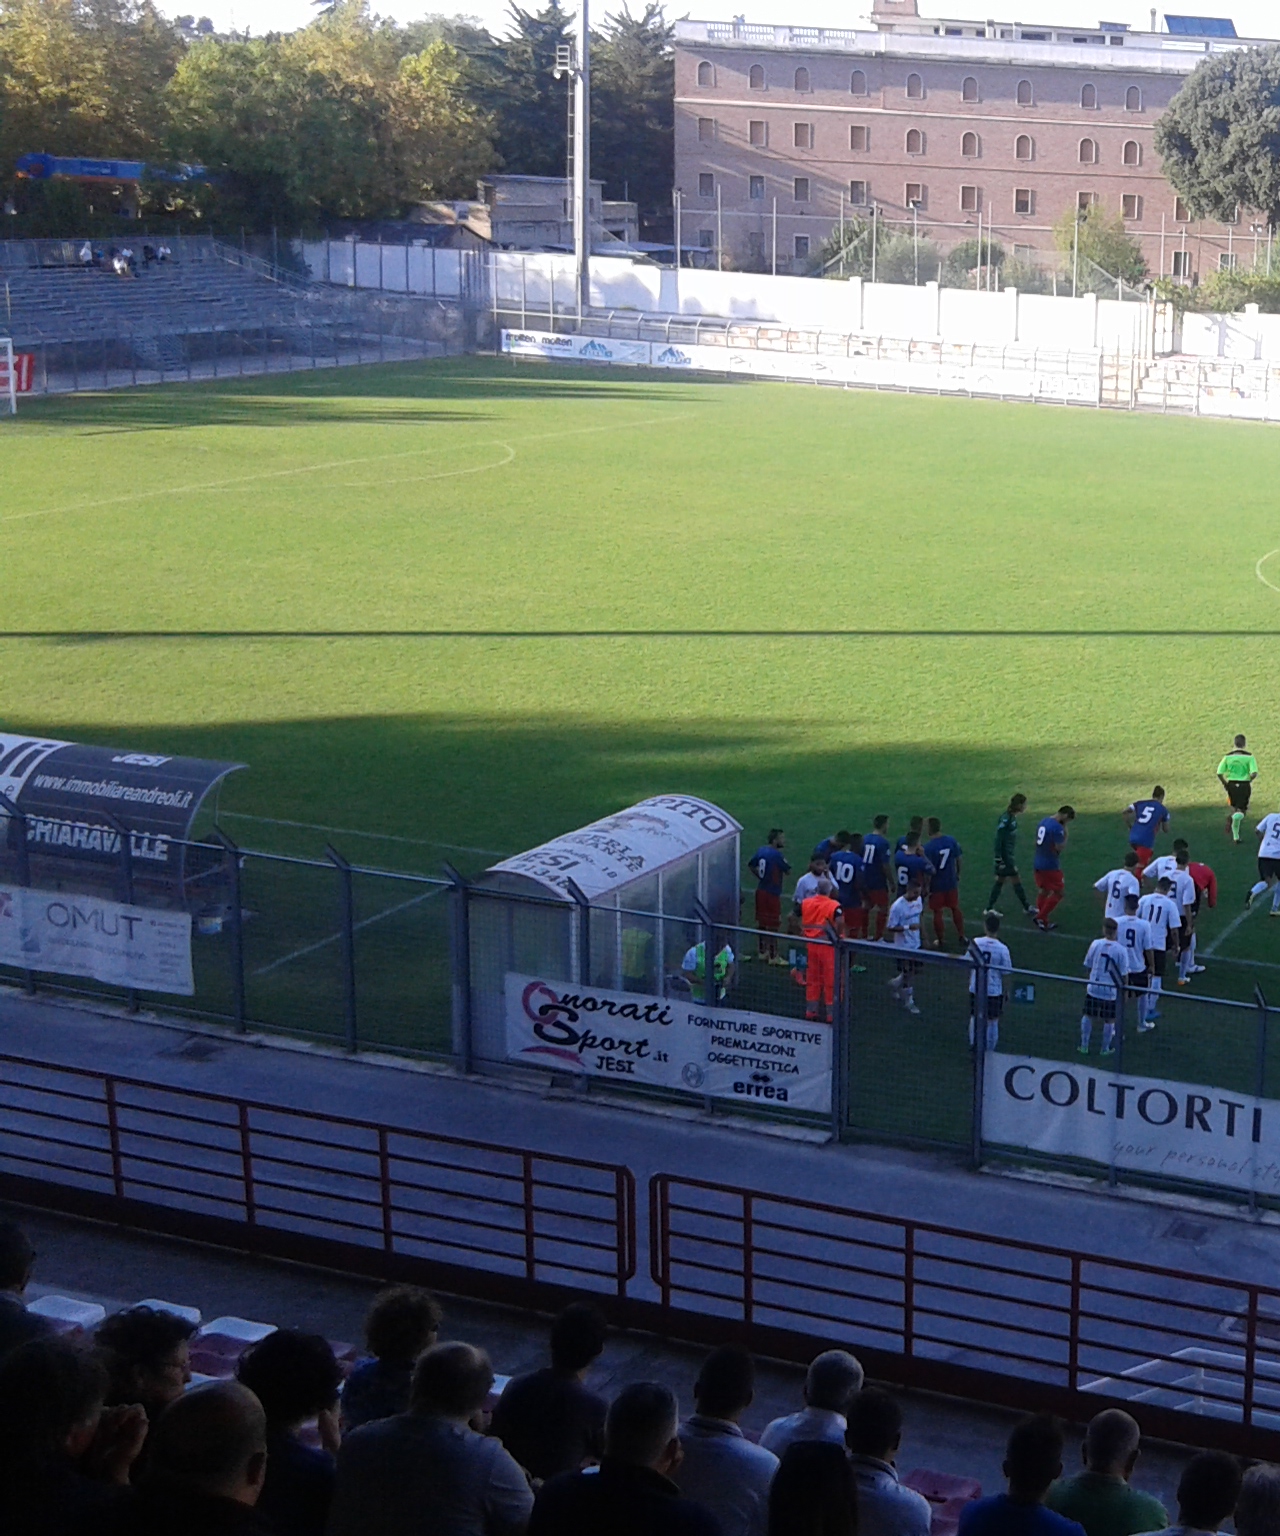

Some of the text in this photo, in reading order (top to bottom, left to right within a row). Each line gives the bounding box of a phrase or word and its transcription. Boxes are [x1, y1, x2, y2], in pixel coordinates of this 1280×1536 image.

[541, 336, 573, 346] molten
[0, 740, 58, 779] li
[112, 753, 173, 767] JESI
[33, 774, 194, 808] www.immobiliareandreoli.it
[1138, 806, 1155, 824] 5
[1036, 826, 1046, 846] 9
[863, 844, 876, 864] 11
[939, 848, 950, 870] 7
[758, 858, 767, 879] 8
[836, 861, 854, 883] 10
[897, 866, 909, 885] 6
[1111, 880, 1121, 899] 6
[46, 902, 143, 940] OMUT
[1148, 904, 1163, 924] 11
[1125, 928, 1136, 949] 9
[1100, 952, 1112, 973] 7
[521, 980, 674, 1027] Onorati
[687, 1014, 822, 1045] FORNITURE SPORTIVE
[711, 1035, 796, 1057] PREMIAZIONI
[596, 1055, 635, 1074] JESI
[707, 1052, 800, 1074] OGGETTISTICA
[1004, 1064, 1262, 1143] COLTORTI
[1112, 1140, 1154, 1159] your
[1163, 1146, 1248, 1174] personal
